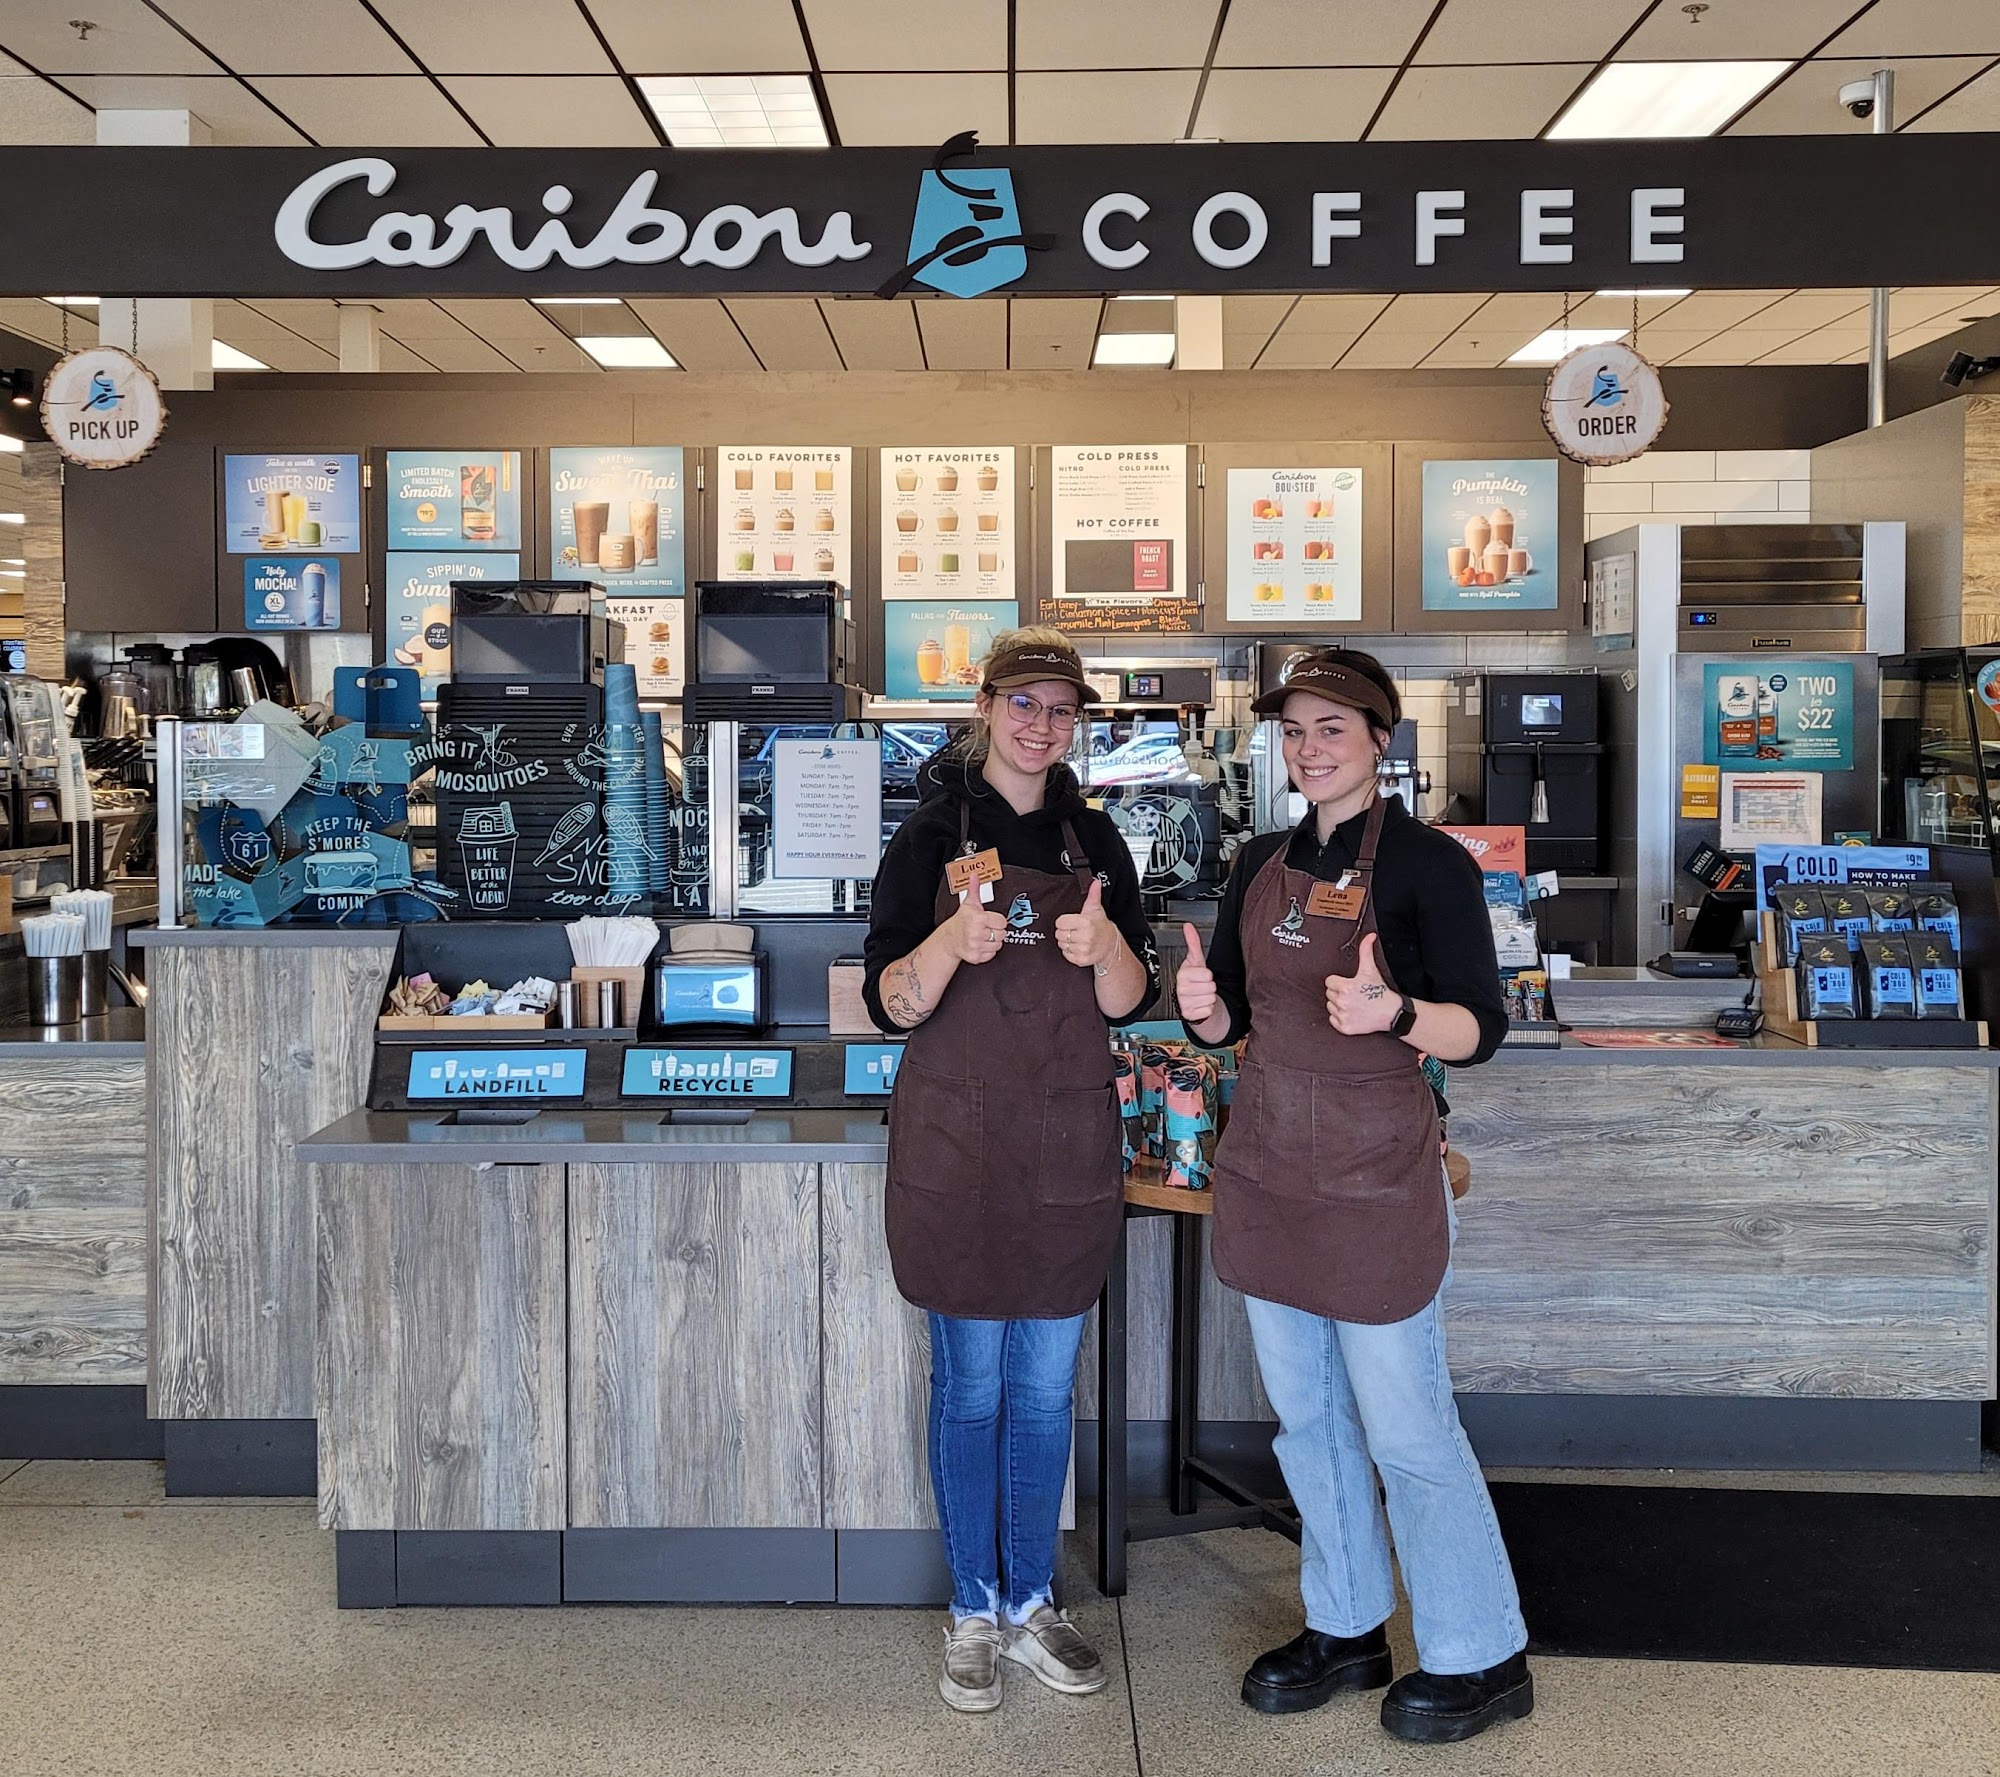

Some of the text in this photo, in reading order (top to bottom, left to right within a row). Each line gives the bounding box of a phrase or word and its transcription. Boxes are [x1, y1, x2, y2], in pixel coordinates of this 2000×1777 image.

[275, 157, 1686, 271] Caribou COFFEE
[69, 420, 139, 440] PICK UP
[1578, 415, 1637, 436] ORDER
[266, 458, 285, 467] Take
[295, 458, 316, 467] walk
[597, 455, 636, 465] WAKE UP
[727, 453, 841, 461] COLD FAVORITES
[895, 453, 1000, 463] HOT FAVORITES
[1077, 452, 1159, 461] COLD PRESS
[400, 467, 455, 478] LIMITED BATCH
[627, 469, 679, 490] Thai
[1272, 471, 1316, 481] Caribou
[246, 474, 336, 494] LIGHTER SIDE
[1452, 477, 1528, 496] Pumpkin
[399, 484, 454, 499] Smooth
[1476, 496, 1504, 505] IS REAL
[1077, 518, 1160, 528] HOT COFFEE
[1139, 546, 1161, 554] FRENCH
[1141, 554, 1159, 563] ROAST
[261, 565, 288, 578] Holy
[426, 563, 485, 579] SIPPIN' ON
[255, 577, 297, 591] MOCHA!
[402, 577, 451, 598] Suns
[269, 597, 281, 605] XL
[1039, 598, 1057, 610] Earl
[605, 606, 655, 614] AKFAST
[911, 608, 995, 621] FALLING Flavors
[1059, 609, 1104, 618] Cinnamon
[1796, 676, 1836, 696] TWO
[403, 740, 478, 767] BRING IT
[435, 759, 549, 793] MOSQUITOES
[562, 757, 590, 788] AROUND
[591, 780, 608, 792] THE
[669, 809, 709, 828] MOC
[304, 816, 373, 838] KEEP THE
[1153, 815, 1181, 842] SIDE
[241, 842, 260, 858] 61
[308, 835, 371, 852] S'MORES
[572, 833, 618, 857] NO
[1453, 833, 1490, 857] ting
[475, 847, 499, 861] LIFE
[850, 852, 867, 860] 4-7pm
[546, 852, 640, 887] SNOW
[961, 860, 987, 874] Lucy
[1692, 850, 1713, 875] SUMATRA
[1796, 856, 1838, 877] COLD
[470, 867, 508, 881] BETTER
[1876, 872, 1888, 880] TO
[1891, 872, 1917, 880] MAKE
[192, 886, 242, 900] the lake
[475, 890, 505, 904] CABIN
[673, 886, 709, 907] LA
[1327, 890, 1348, 899] Lena
[317, 894, 369, 911] COMIN'
[544, 889, 642, 916] too deep
[1005, 929, 1046, 939] ribou
[1271, 926, 1310, 944] Caribou
[1829, 972, 1845, 980] COLD
[1890, 972, 1907, 980] COLD
[1935, 973, 1951, 981] COLD
[1528, 979, 1537, 998] KIND
[444, 1078, 548, 1095] LANDFILL
[659, 1078, 755, 1093] RECYCLE
[882, 1076, 894, 1090] L
